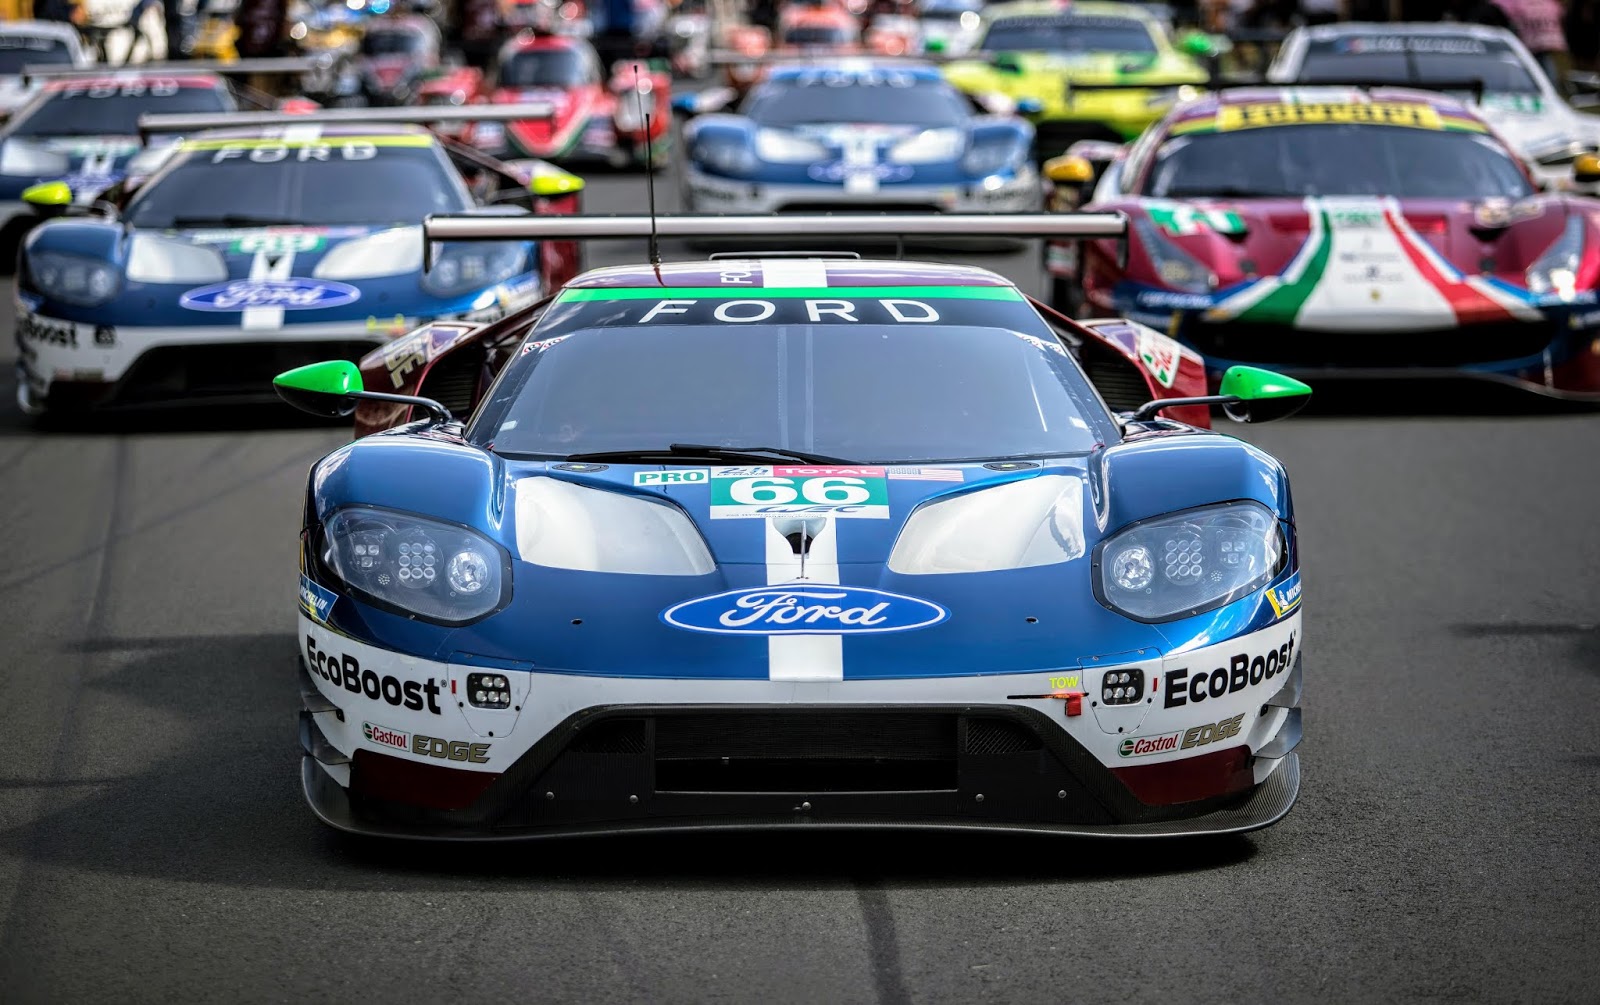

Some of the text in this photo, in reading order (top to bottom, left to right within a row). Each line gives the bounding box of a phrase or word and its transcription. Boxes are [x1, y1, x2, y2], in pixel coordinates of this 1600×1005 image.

[211, 141, 378, 164] FORD
[637, 299, 940, 323] FORD
[638, 471, 705, 484] PRO
[729, 476, 871, 505] 66
[718, 591, 891, 626] Ford
[1048, 676, 1079, 689] TOW
[373, 726, 493, 764] Castrol EDGE
[1134, 712, 1246, 754] Castrol EDGE
